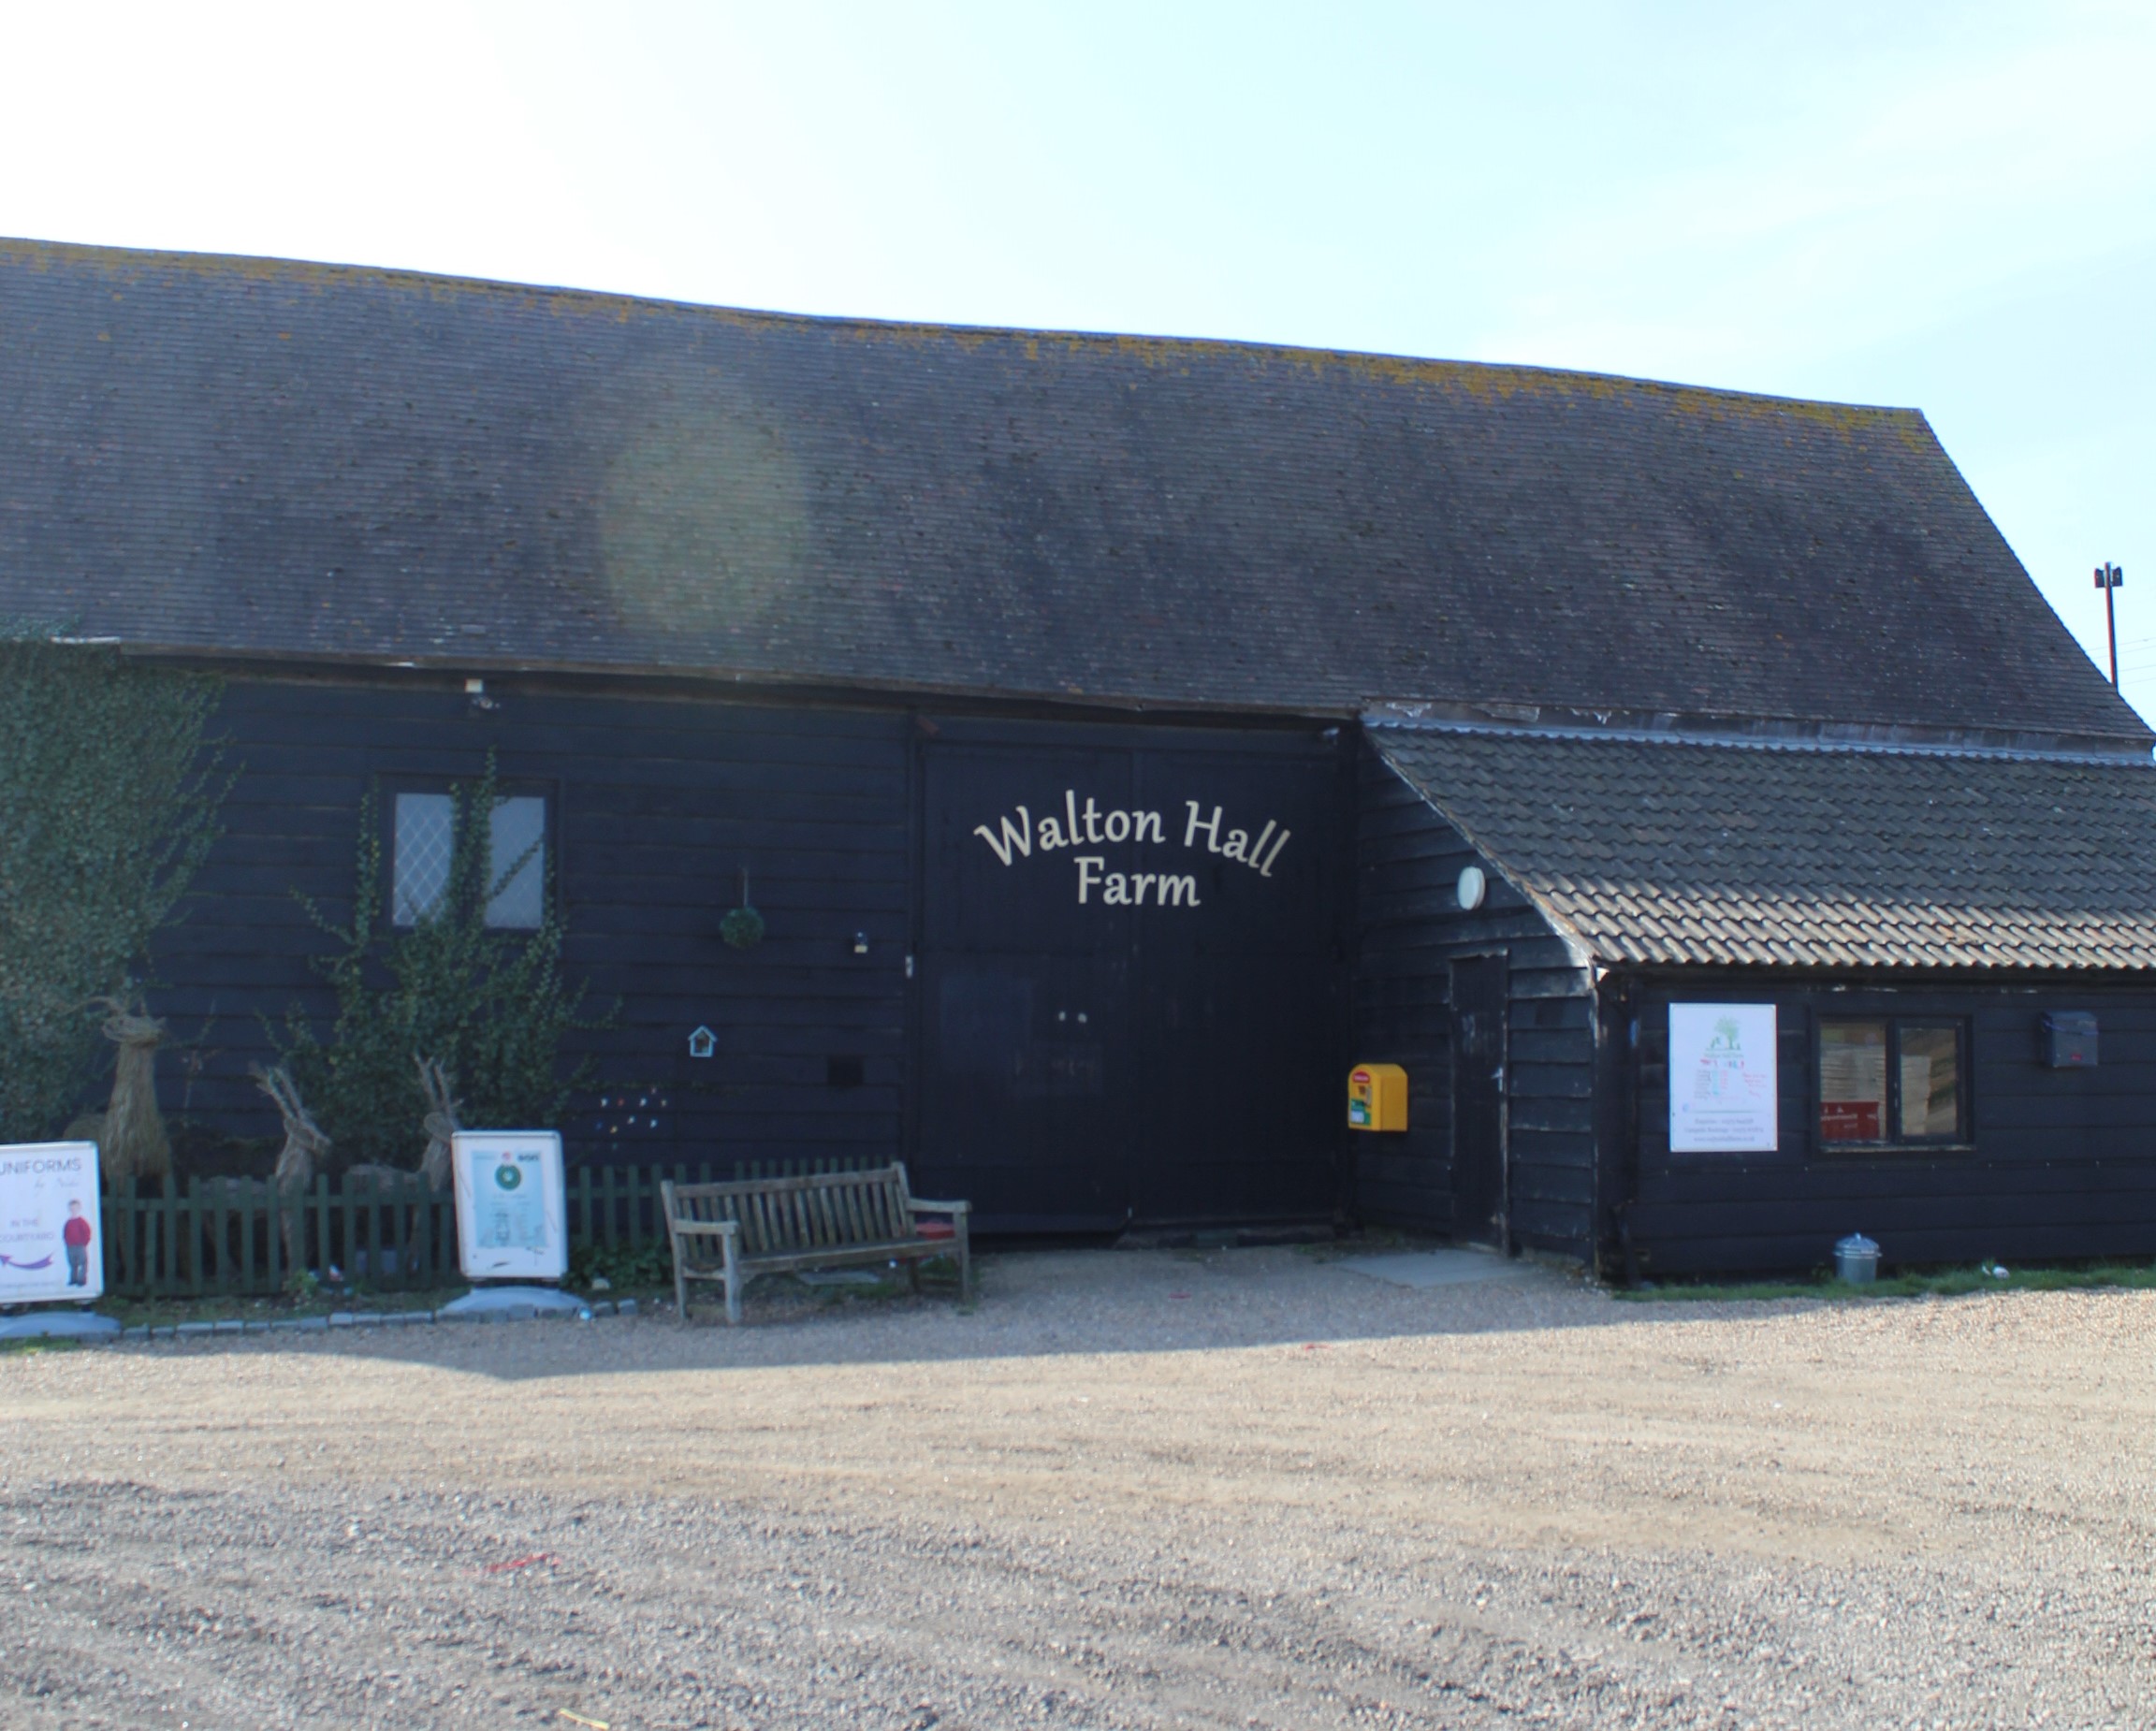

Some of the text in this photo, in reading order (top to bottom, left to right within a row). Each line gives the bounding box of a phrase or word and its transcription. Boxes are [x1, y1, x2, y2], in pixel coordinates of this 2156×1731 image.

[973, 789, 1291, 878] Walton Hall
[1073, 856, 1202, 907] Farm
